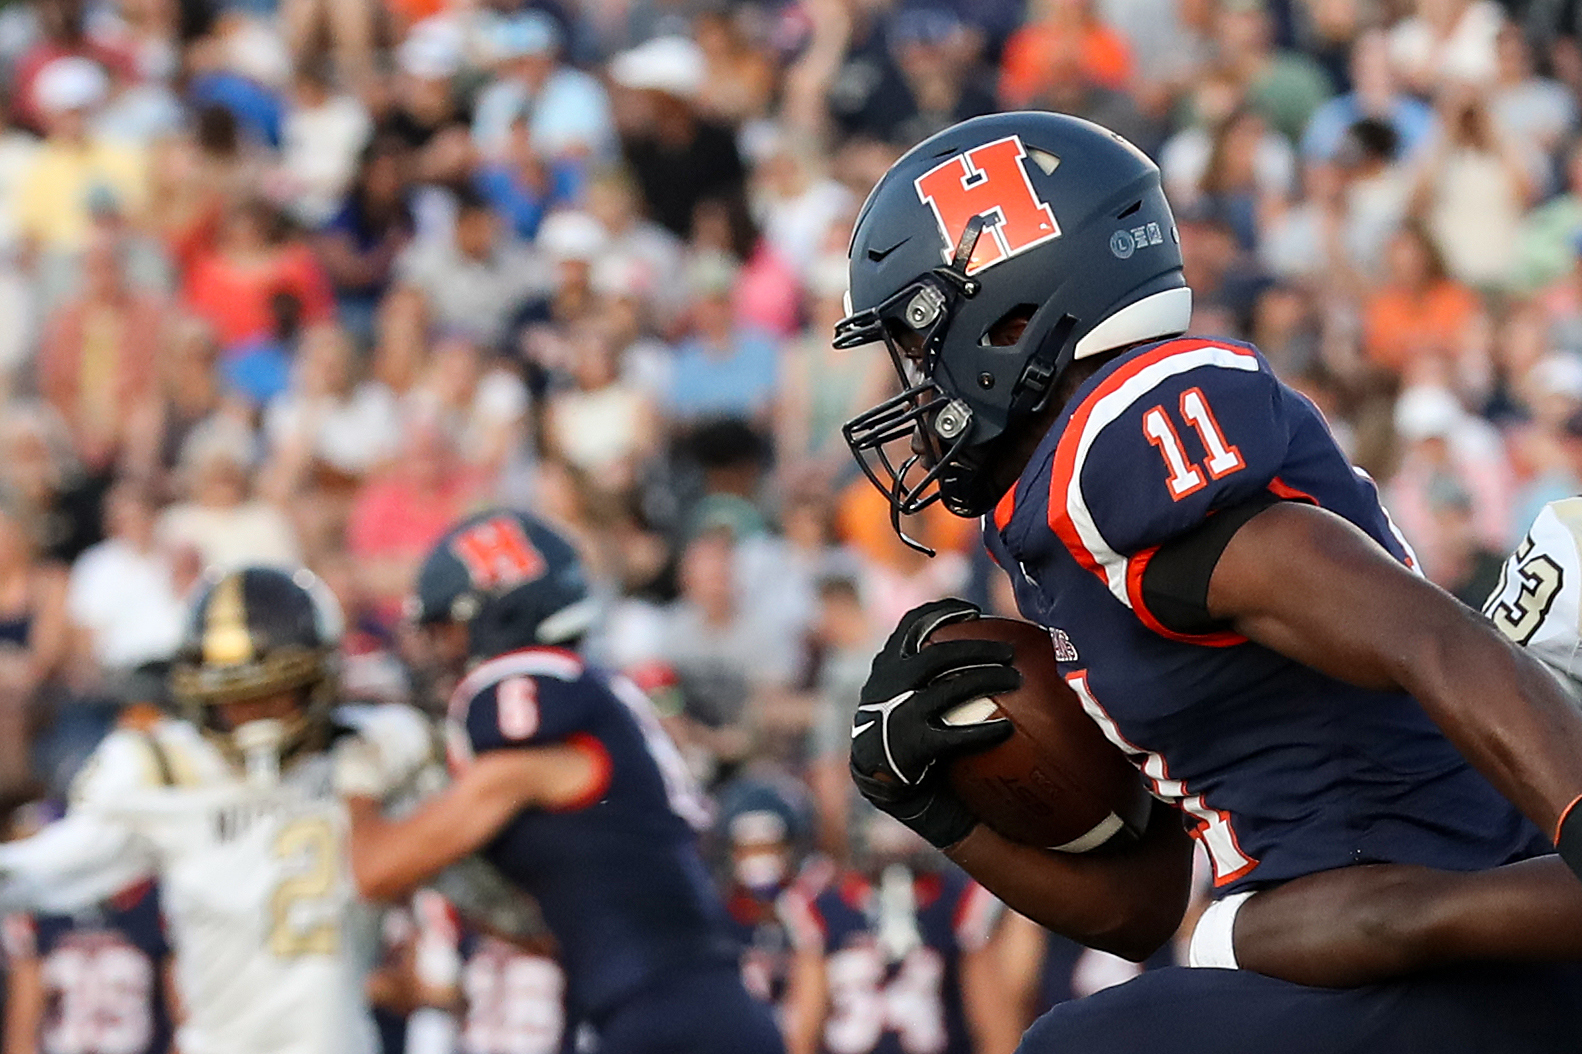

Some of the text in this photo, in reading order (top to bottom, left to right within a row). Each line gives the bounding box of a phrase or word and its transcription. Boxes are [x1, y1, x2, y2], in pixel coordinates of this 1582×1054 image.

[914, 134, 1061, 276] H
[1143, 387, 1245, 502] 11
[268, 817, 341, 958] 2
